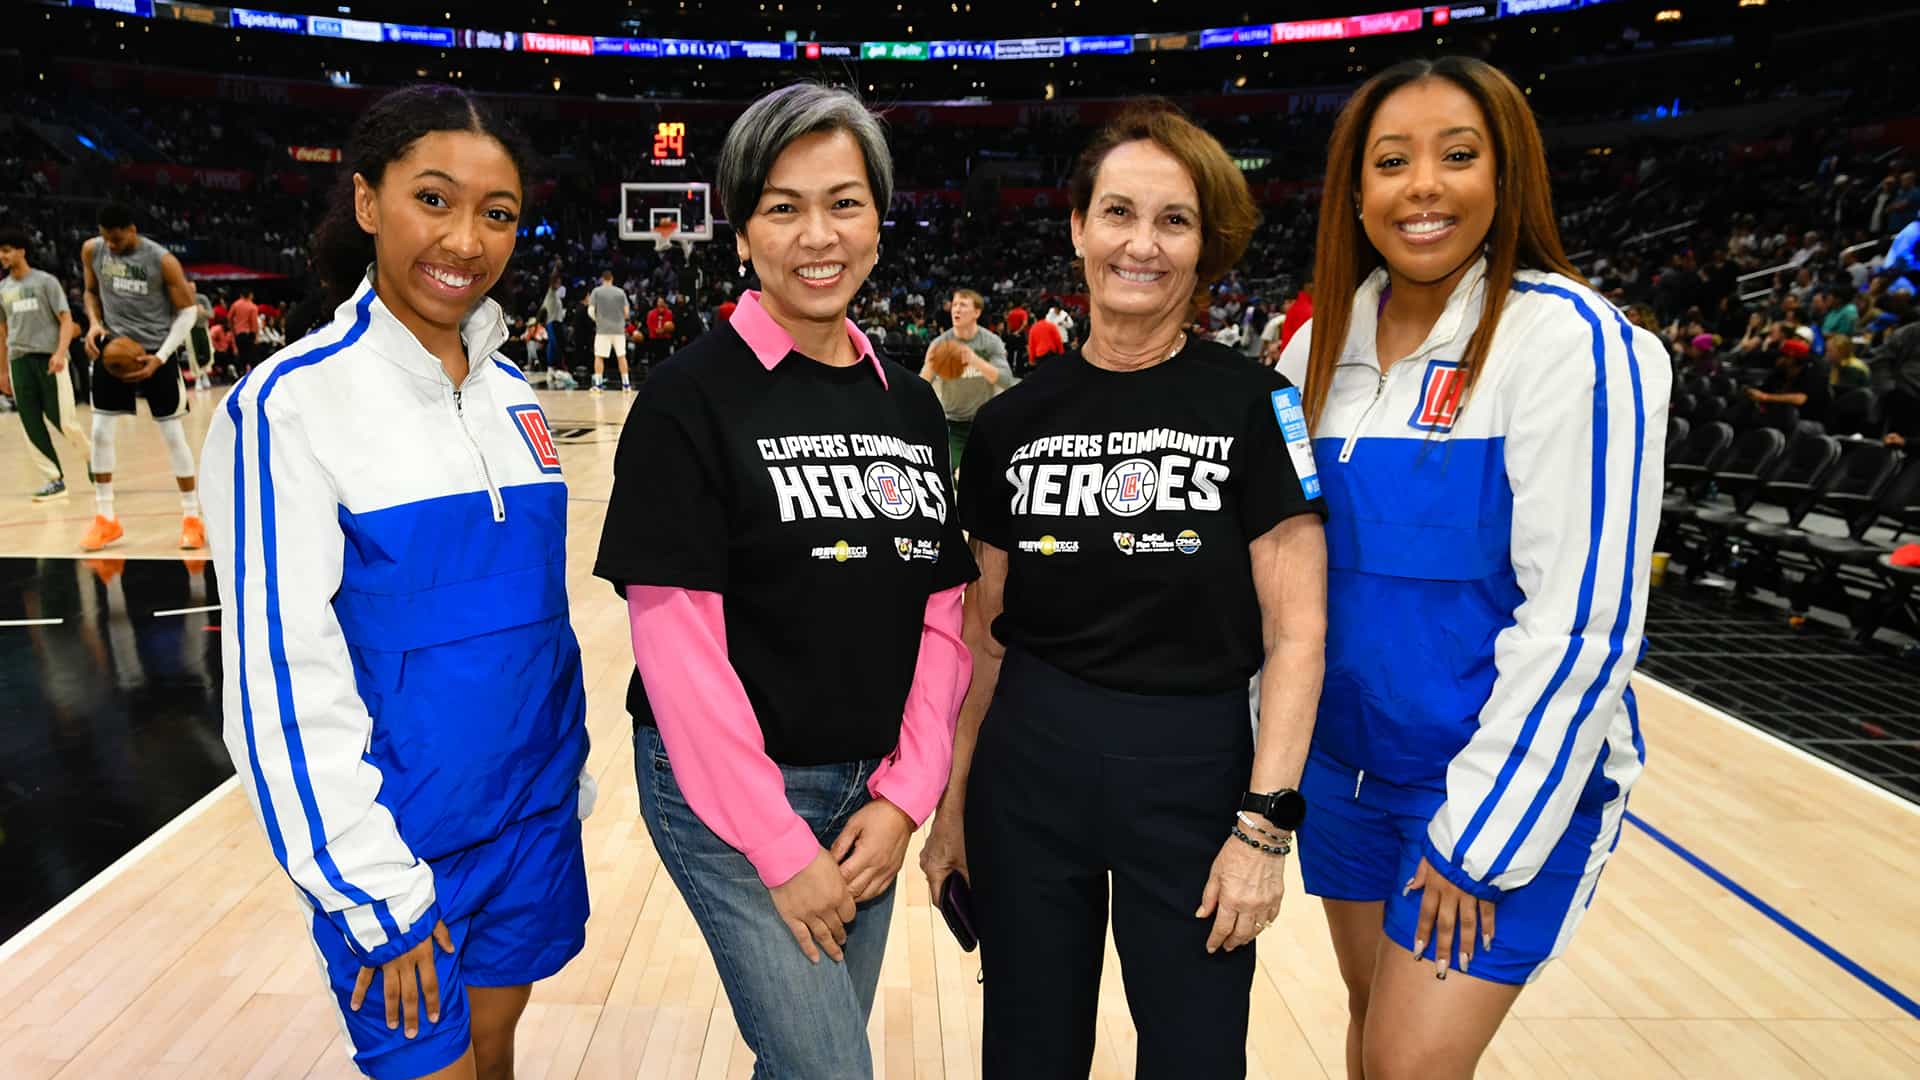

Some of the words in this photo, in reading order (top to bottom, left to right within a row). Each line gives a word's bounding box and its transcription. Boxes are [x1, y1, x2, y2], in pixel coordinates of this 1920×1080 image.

[238, 13, 298, 29] Spectrum
[1276, 22, 1342, 40] TOSHIBA
[527, 36, 590, 54] TOSHIBA
[680, 43, 724, 56] DELTA
[947, 45, 992, 57] DELTA
[654, 133, 683, 157] 24
[757, 434, 850, 460] CLIPPERS
[1010, 434, 1103, 465] CLIPPERS
[1107, 427, 1234, 461] COMMUNITY
[767, 461, 947, 525] HEROES
[1006, 454, 1231, 516] HEROES
